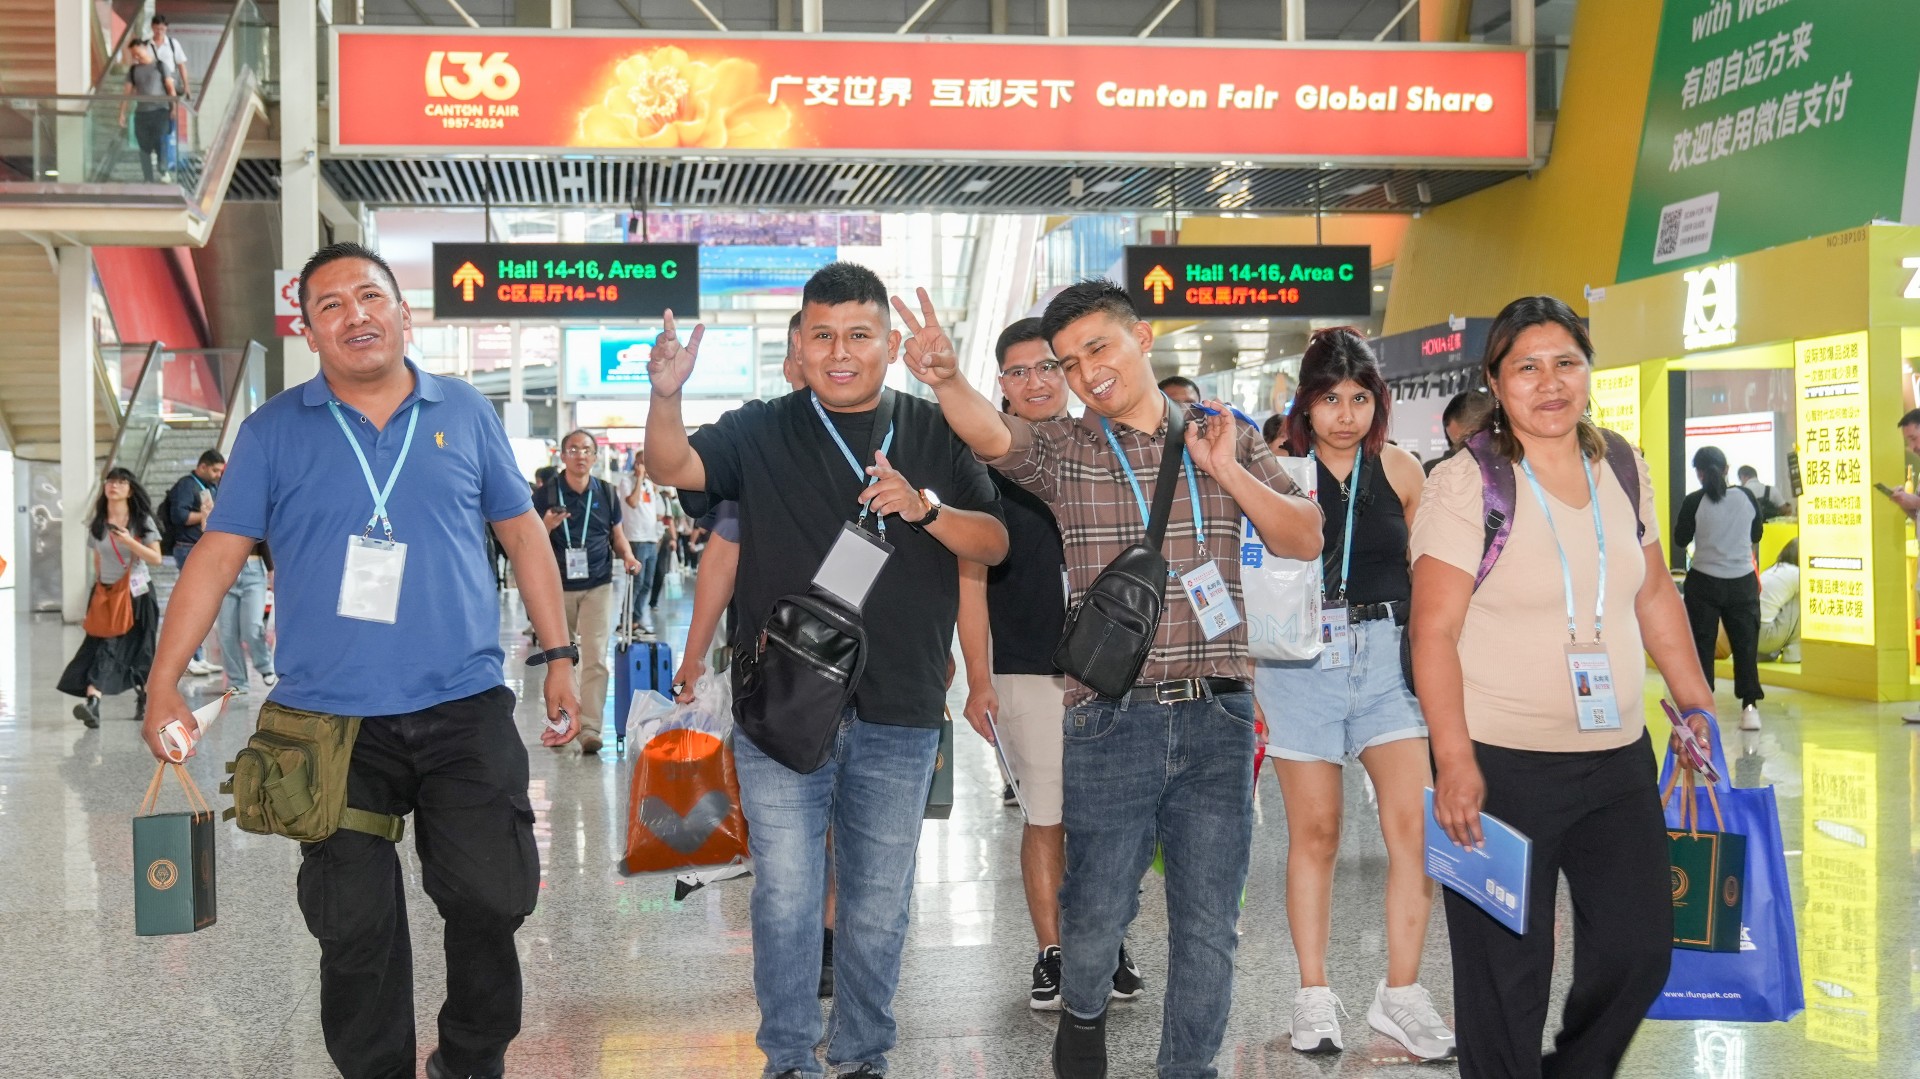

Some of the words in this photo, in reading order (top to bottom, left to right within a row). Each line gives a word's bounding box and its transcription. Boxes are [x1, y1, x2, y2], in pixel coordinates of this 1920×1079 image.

[1692, 0, 1732, 42] with
[425, 51, 520, 101] 136
[1681, 22, 1813, 110] 有朋自远方来
[768, 75, 912, 107] 广交世界
[929, 78, 1075, 108] 互利天下
[1096, 82, 1207, 108] Canton
[1218, 83, 1278, 109] Fair
[1295, 85, 1397, 111] Global
[1406, 86, 1493, 112] Share
[424, 104, 483, 116] CANTON
[488, 104, 519, 117] FAIR
[442, 118, 504, 129] 1957-2024
[1669, 71, 1852, 172] 欢迎使用微信支付
[498, 260, 538, 279] Hall
[543, 260, 604, 281] 14-16,
[608, 260, 656, 279] Area
[661, 260, 677, 279] C
[1186, 264, 1224, 281] Hall
[1229, 264, 1286, 283] 14-16,
[1289, 264, 1334, 281] Area
[1338, 263, 1354, 281] C
[1806, 428, 1830, 453] 产品
[1835, 425, 1861, 451] 系统
[1806, 460, 1830, 485] 服务
[1835, 458, 1861, 484] 体验
[1664, 991, 1741, 999] www.ifunpark.com
